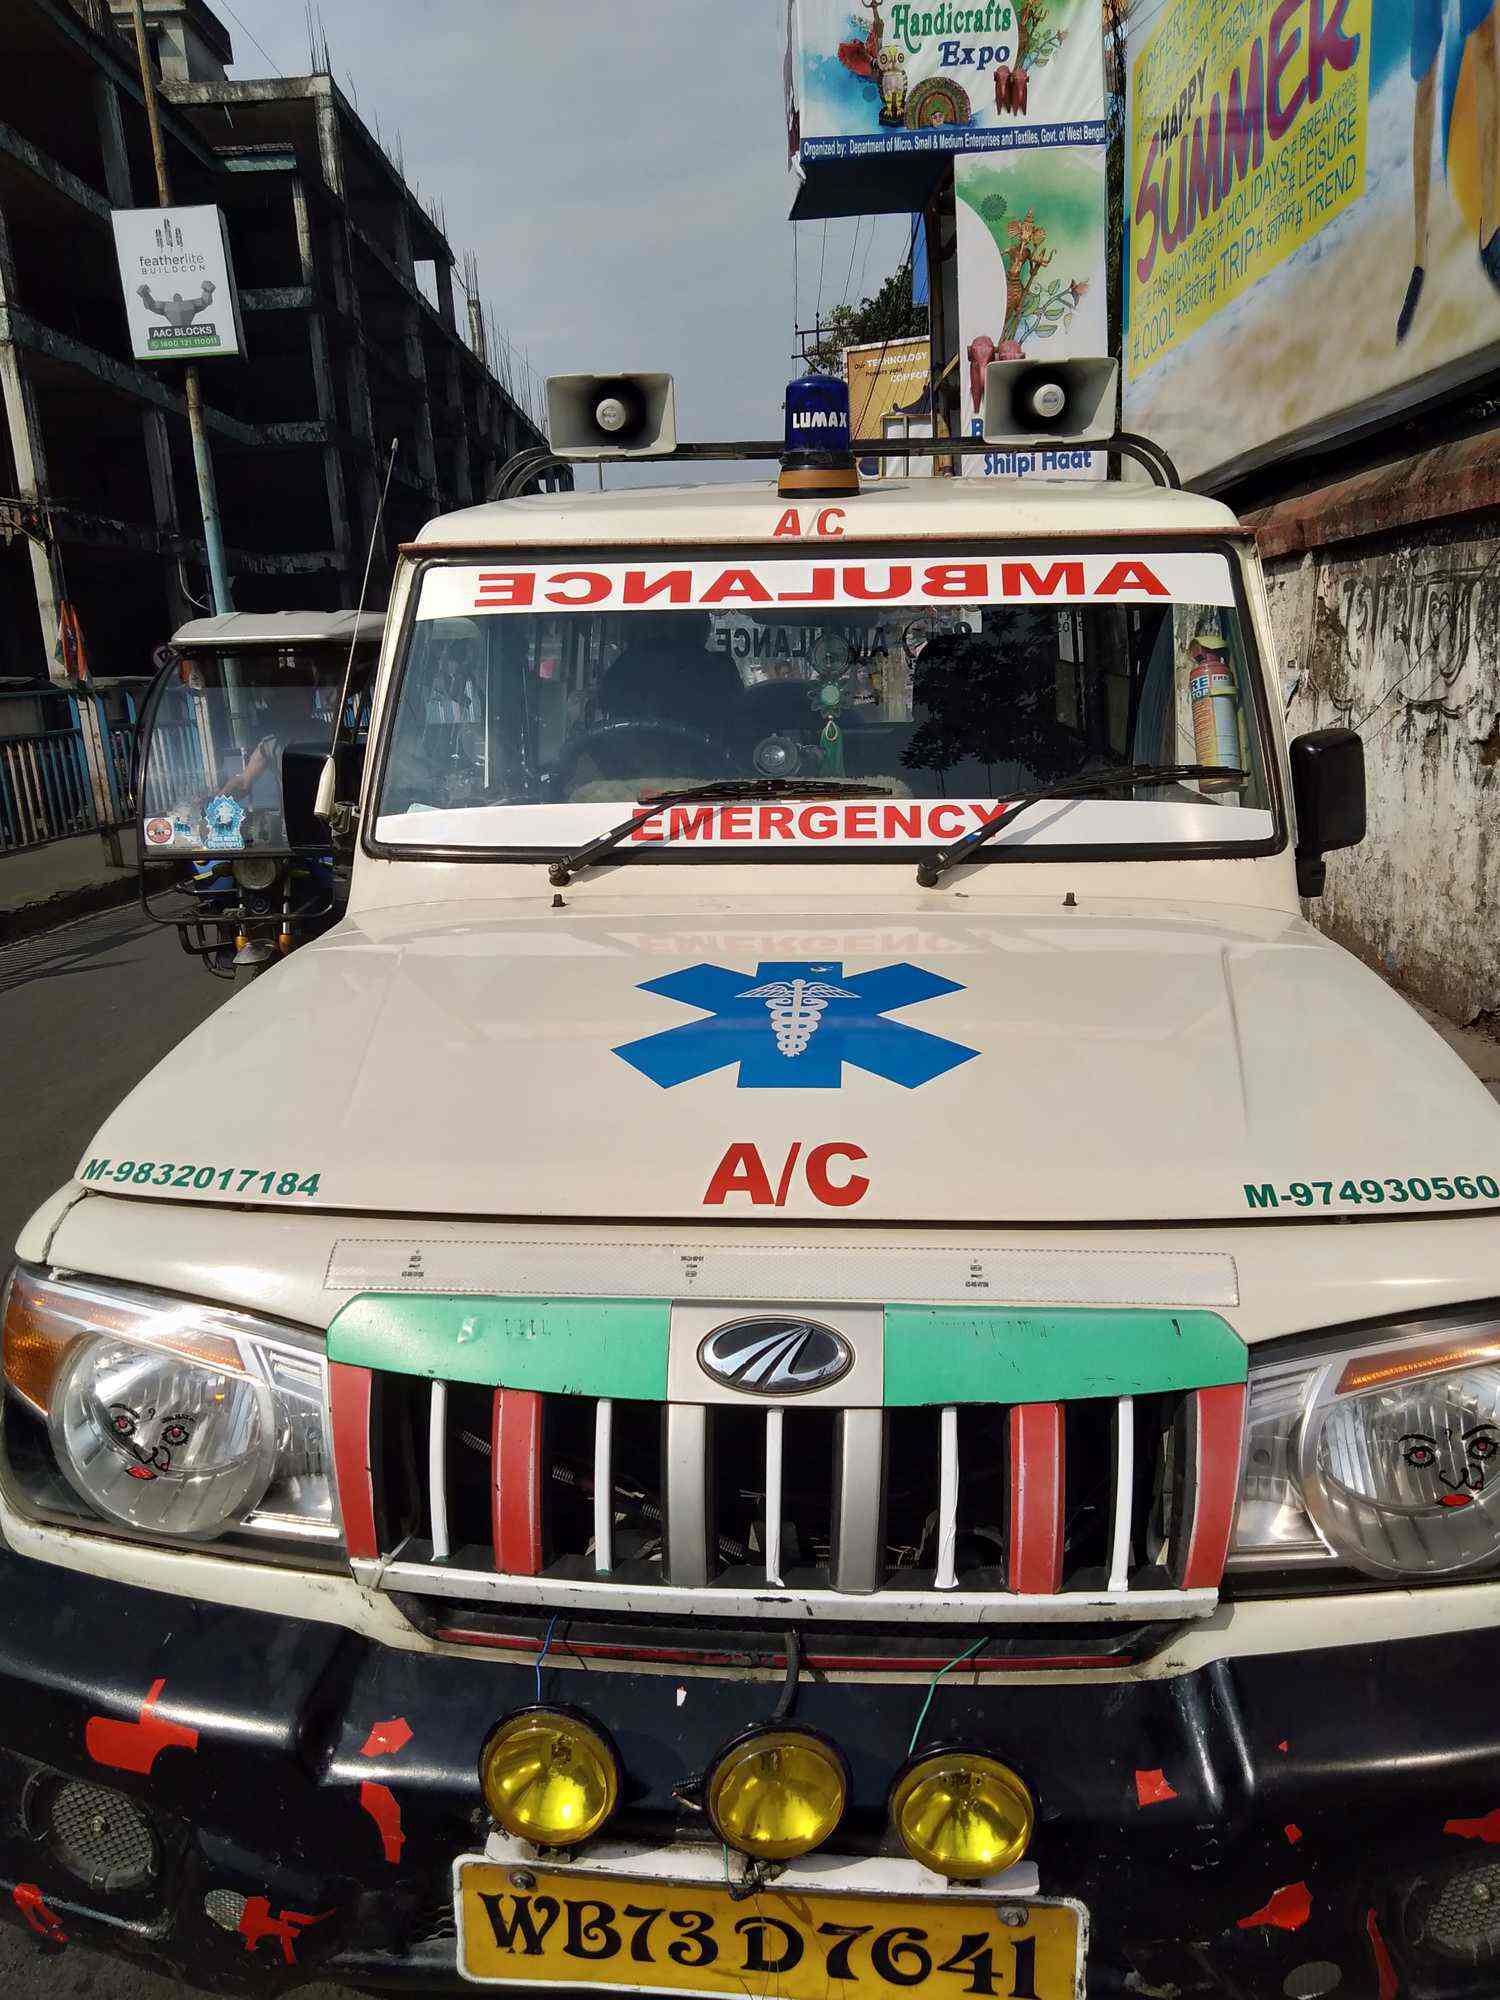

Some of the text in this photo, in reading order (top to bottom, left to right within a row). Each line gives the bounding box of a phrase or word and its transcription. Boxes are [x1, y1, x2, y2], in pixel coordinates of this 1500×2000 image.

[891, 0, 1011, 54] Handicrafts
[938, 41, 1010, 70] Expo
[1160, 57, 1208, 157] HAPPY
[803, 141, 835, 159] Organized
[849, 138, 886, 157] Department
[886, 138, 894, 152] of
[914, 135, 932, 150] Small
[939, 132, 964, 149] Medium
[964, 132, 1001, 149] Enterprises
[1001, 132, 1014, 146] and
[1058, 126, 1066, 142] of
[1066, 125, 1083, 141] West
[1083, 123, 1106, 142] Bengal
[140, 252, 205, 267] featherlite
[142, 264, 206, 275] BUILDCON
[153, 326, 213, 338] AAC BLOCKS
[792, 411, 847, 429] LUMAX
[984, 449, 1092, 477] Shilpi Haat
[773, 507, 846, 537] A/C
[631, 804, 1009, 841] EMERGENCY
[80, 1158, 321, 1197] M-9832017184
[702, 1141, 870, 1207] A/C
[1243, 1174, 1499, 1209] M-974930560
